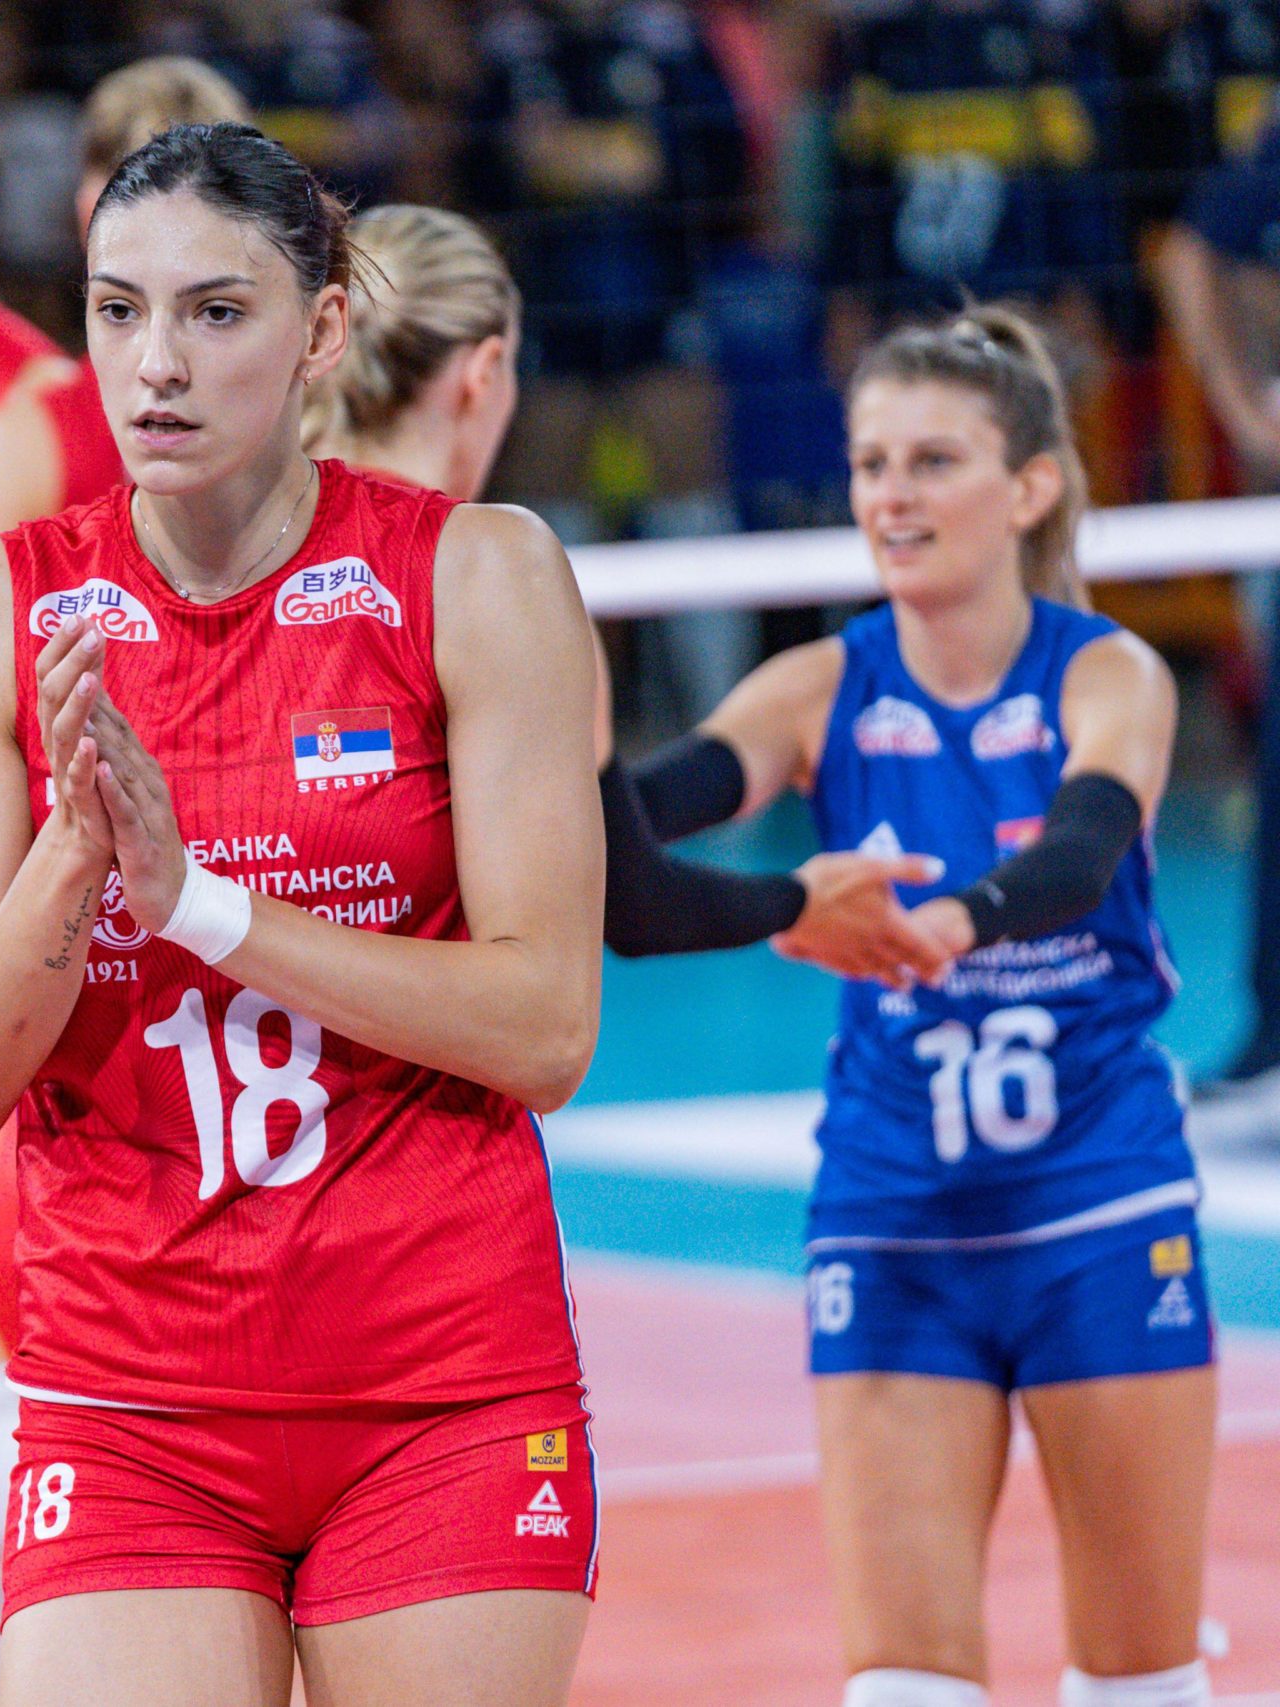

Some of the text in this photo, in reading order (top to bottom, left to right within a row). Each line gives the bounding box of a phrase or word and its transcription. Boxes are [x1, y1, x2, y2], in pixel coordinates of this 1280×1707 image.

[302, 565, 371, 593] 百岁山
[57, 587, 122, 615] 百岁山
[281, 585, 395, 625] Ganten
[297, 771, 394, 793] SERBIA
[188, 833, 297, 864] БАНКА
[221, 861, 396, 896] ШТАНСКА
[86, 959, 139, 984] 1921
[144, 987, 331, 1200] 18
[913, 1004, 1060, 1164] 16
[530, 1455, 565, 1465] MOZZART
[16, 1461, 76, 1550] 18
[515, 1513, 571, 1538] PEAK
